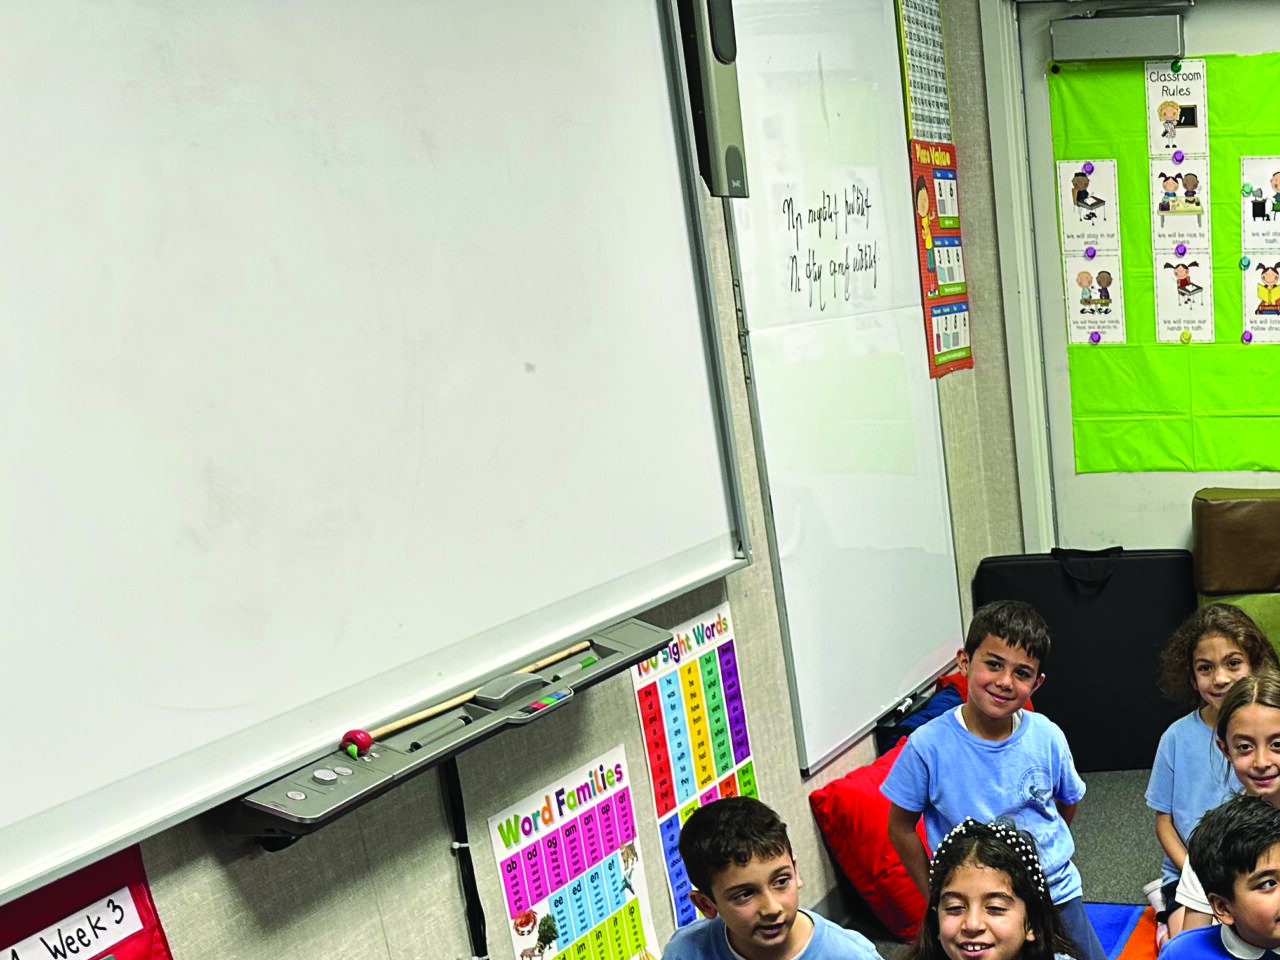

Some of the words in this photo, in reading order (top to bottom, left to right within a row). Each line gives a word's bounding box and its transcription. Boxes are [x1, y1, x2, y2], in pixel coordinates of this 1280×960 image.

[1149, 70, 1202, 83] Classroom
[1161, 85, 1191, 97] Rules
[692, 612, 728, 646] Words
[497, 795, 554, 848] Word
[555, 763, 623, 817] Families
[40, 915, 107, 960] Week
[107, 899, 124, 924] 3
